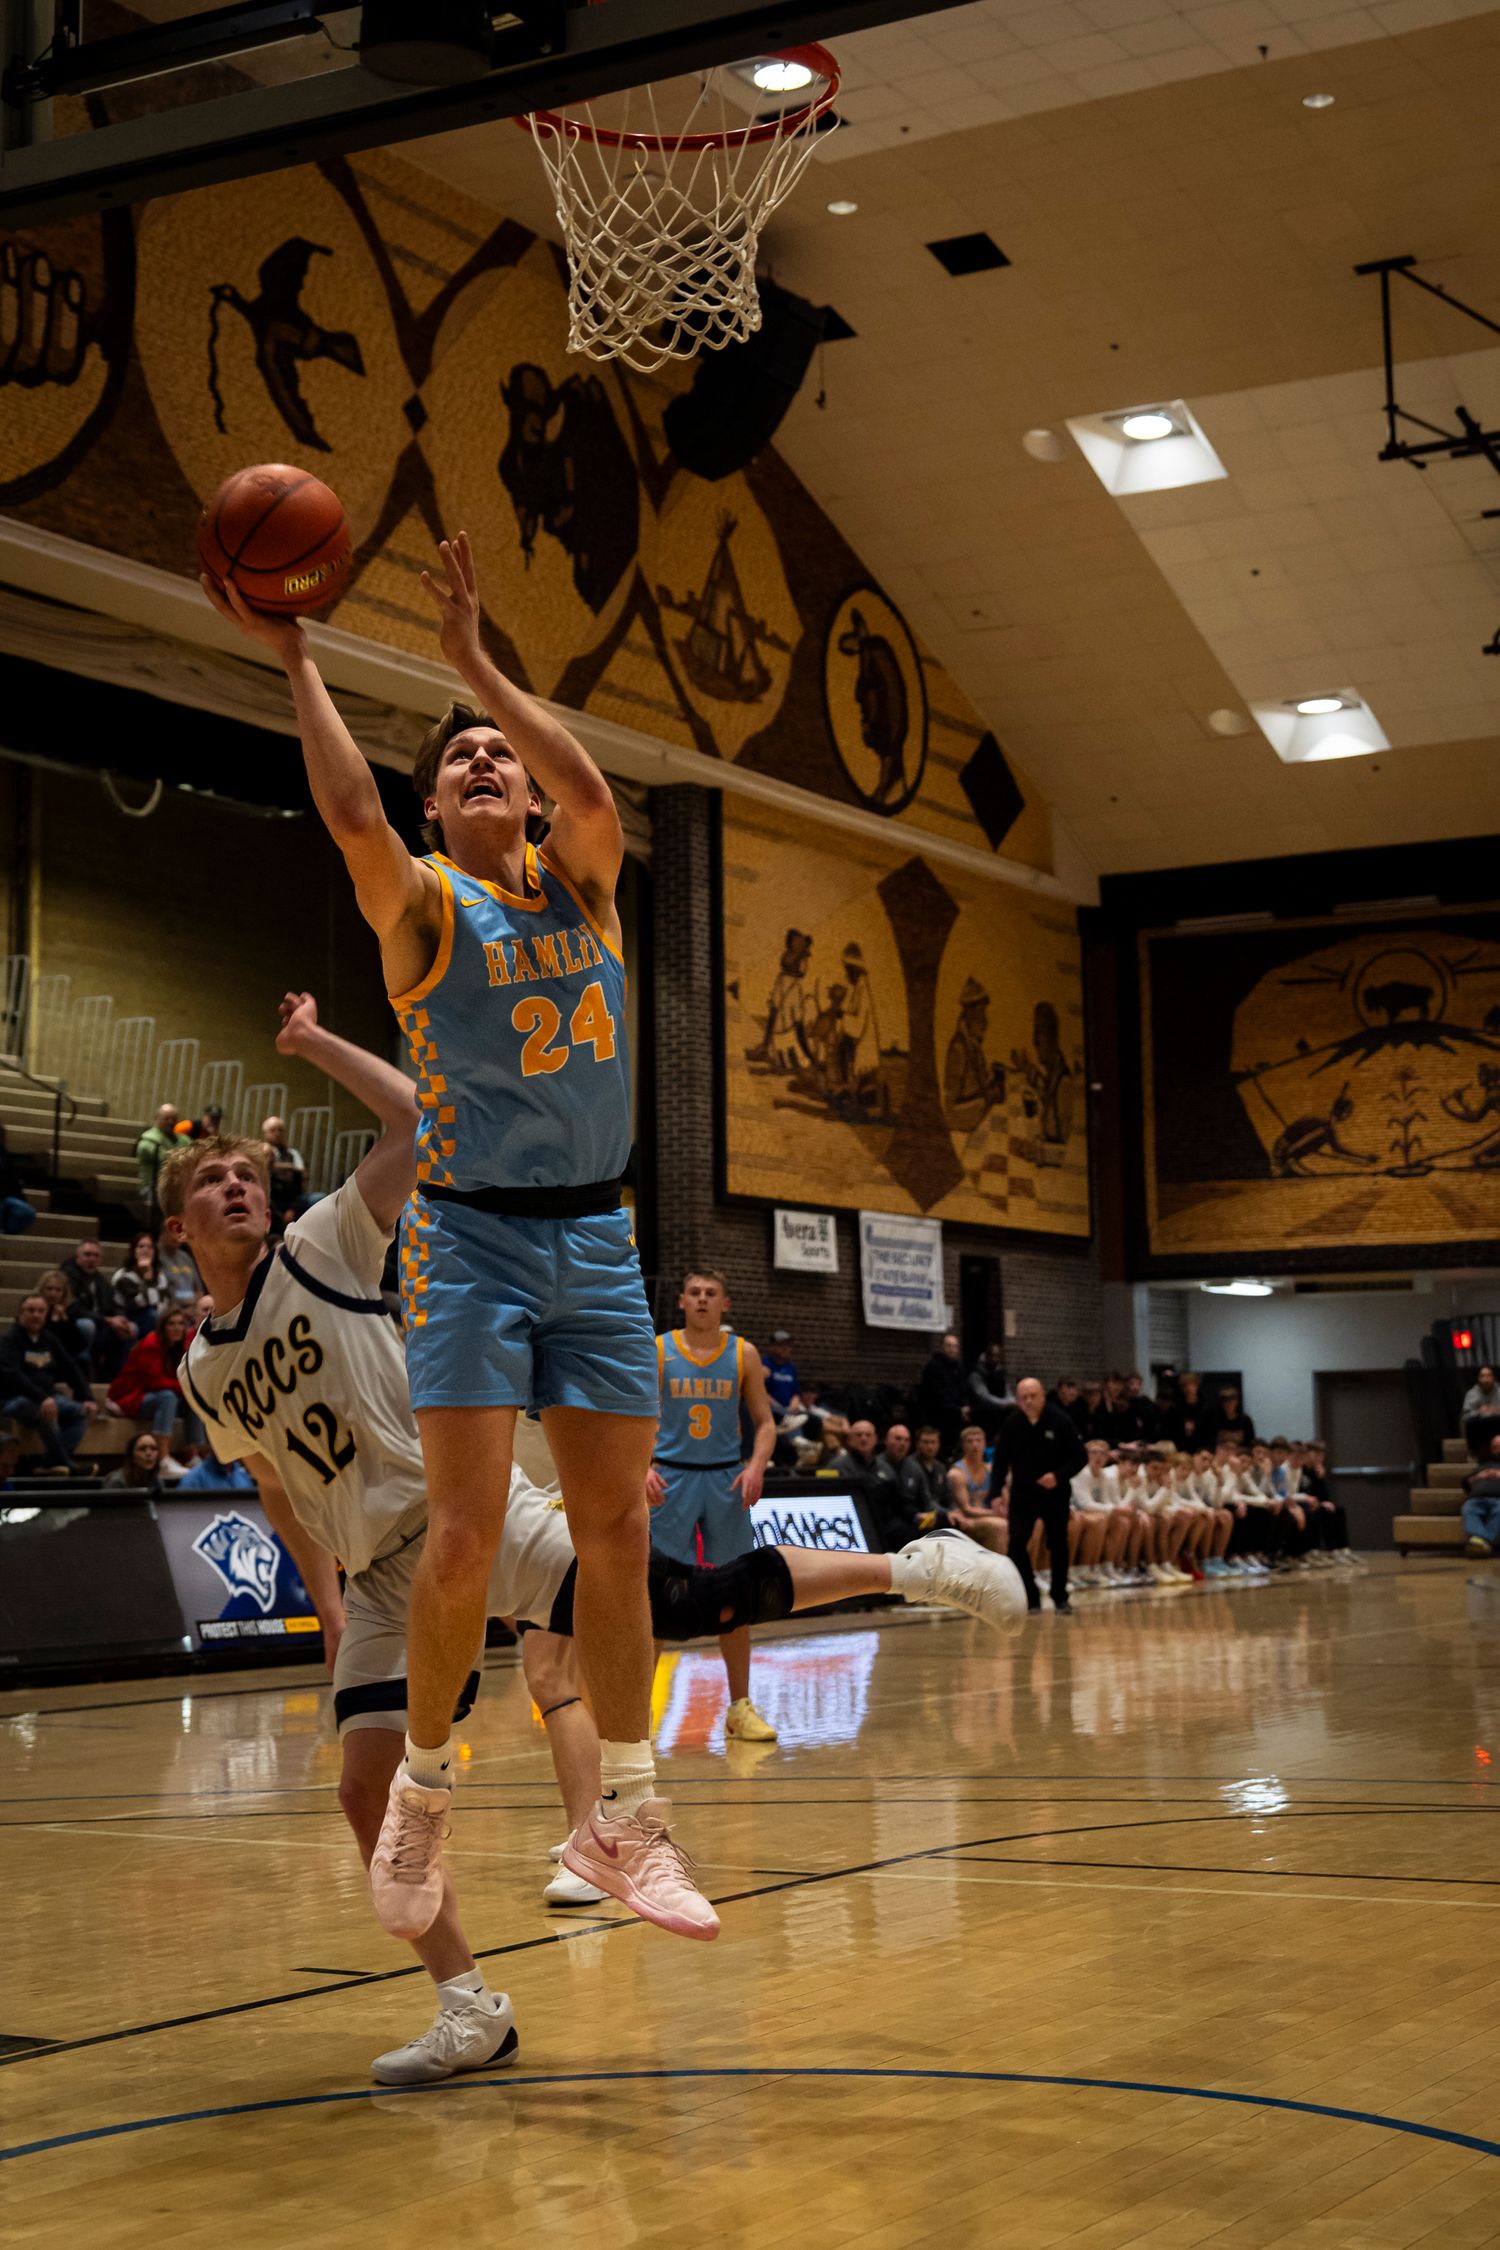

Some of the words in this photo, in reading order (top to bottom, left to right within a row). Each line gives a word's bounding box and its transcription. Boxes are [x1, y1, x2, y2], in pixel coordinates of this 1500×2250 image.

[511, 981, 616, 1077] 24
[223, 1314, 323, 1440] RCCS
[669, 1377, 733, 1400] HAMLIN
[286, 1402, 356, 1485] 12
[688, 1404, 712, 1440] 3
[752, 1510, 861, 1550] nkWest
